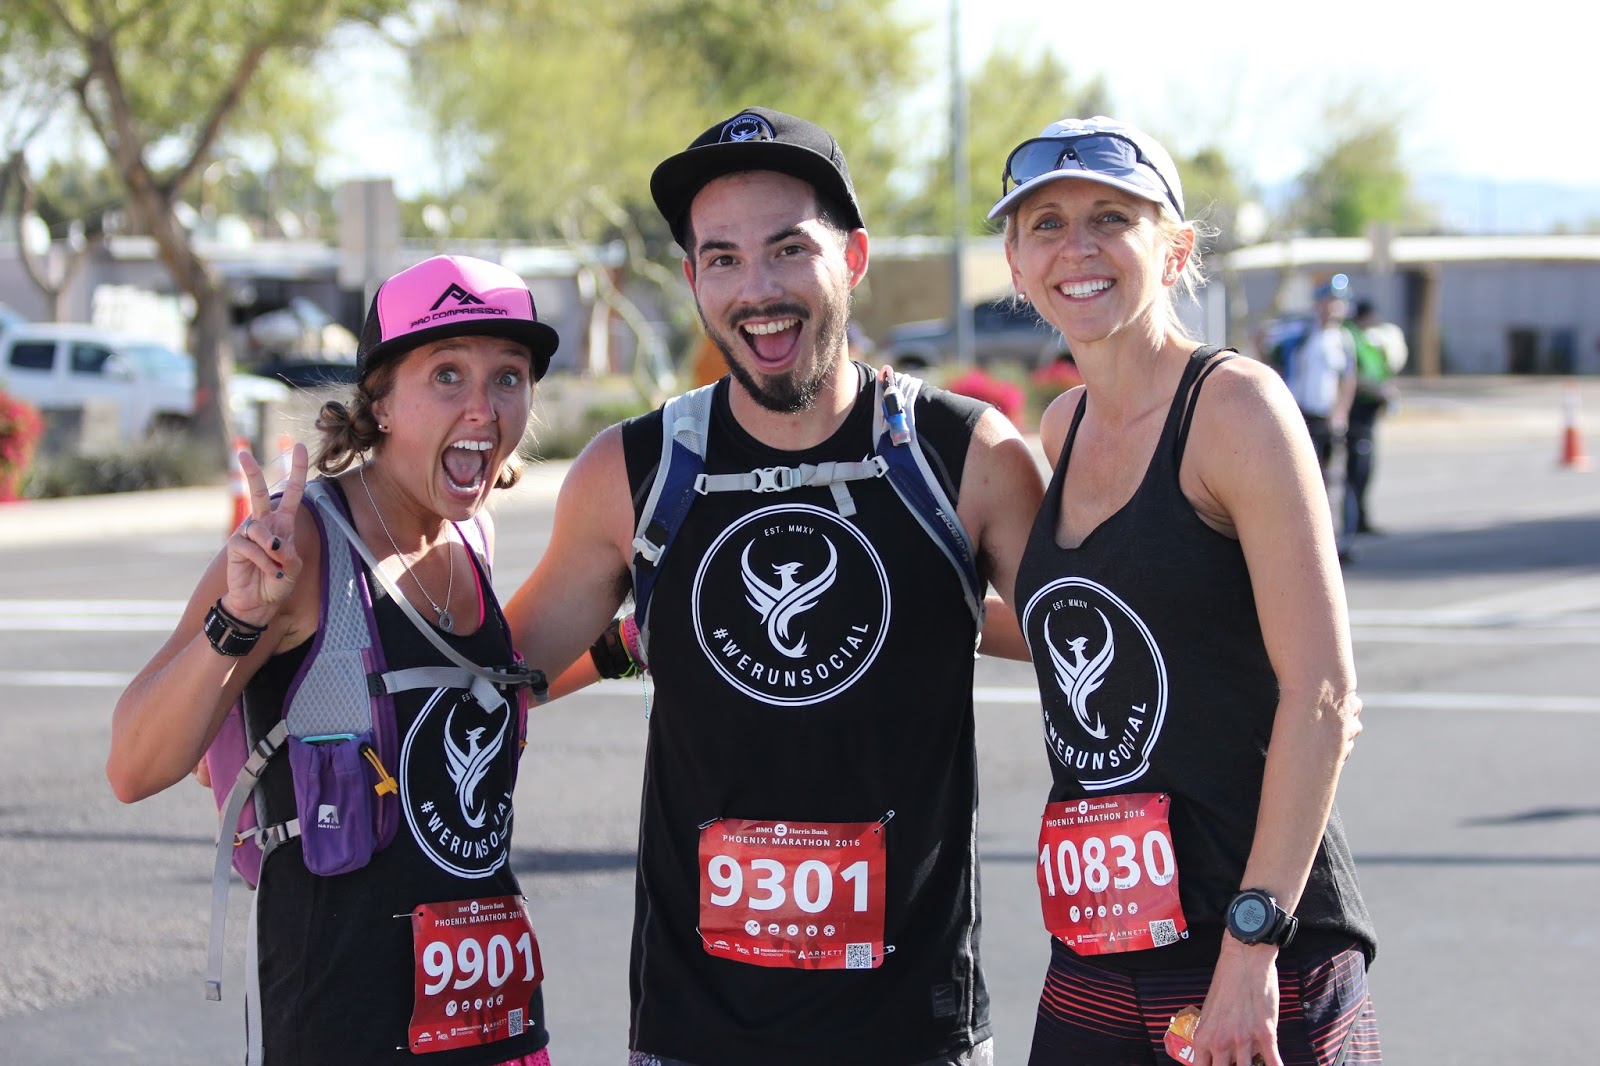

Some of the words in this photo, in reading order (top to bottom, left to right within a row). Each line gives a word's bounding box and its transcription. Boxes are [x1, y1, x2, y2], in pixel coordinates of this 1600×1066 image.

[410, 315, 431, 328] PRO
[432, 308, 508, 319] COMPRESSION
[764, 525, 784, 537] EST.
[788, 525, 815, 535] MMXV
[1052, 599, 1067, 611] EST.
[1068, 598, 1088, 609] MMXV
[713, 623, 869, 687] #WERUNSOCIAL
[1088, 803, 1105, 811] Harris
[1105, 801, 1119, 809] Bank
[420, 791, 512, 859] #WERUNSOIAL
[1046, 817, 1075, 828] PHOENIX
[1077, 812, 1121, 824] MARATHON
[1124, 809, 1146, 819] 2016
[723, 834, 767, 845] PHOENIX
[771, 837, 831, 847] MARATHON
[835, 839, 861, 847] 2016
[1039, 830, 1175, 897] 10830
[707, 855, 869, 913] 9301
[434, 917, 467, 927] PHOENIX
[469, 913, 507, 923] MARATHON
[509, 911, 523, 919] 2016
[1116, 929, 1147, 938] ARNETT
[422, 932, 535, 996] 9901
